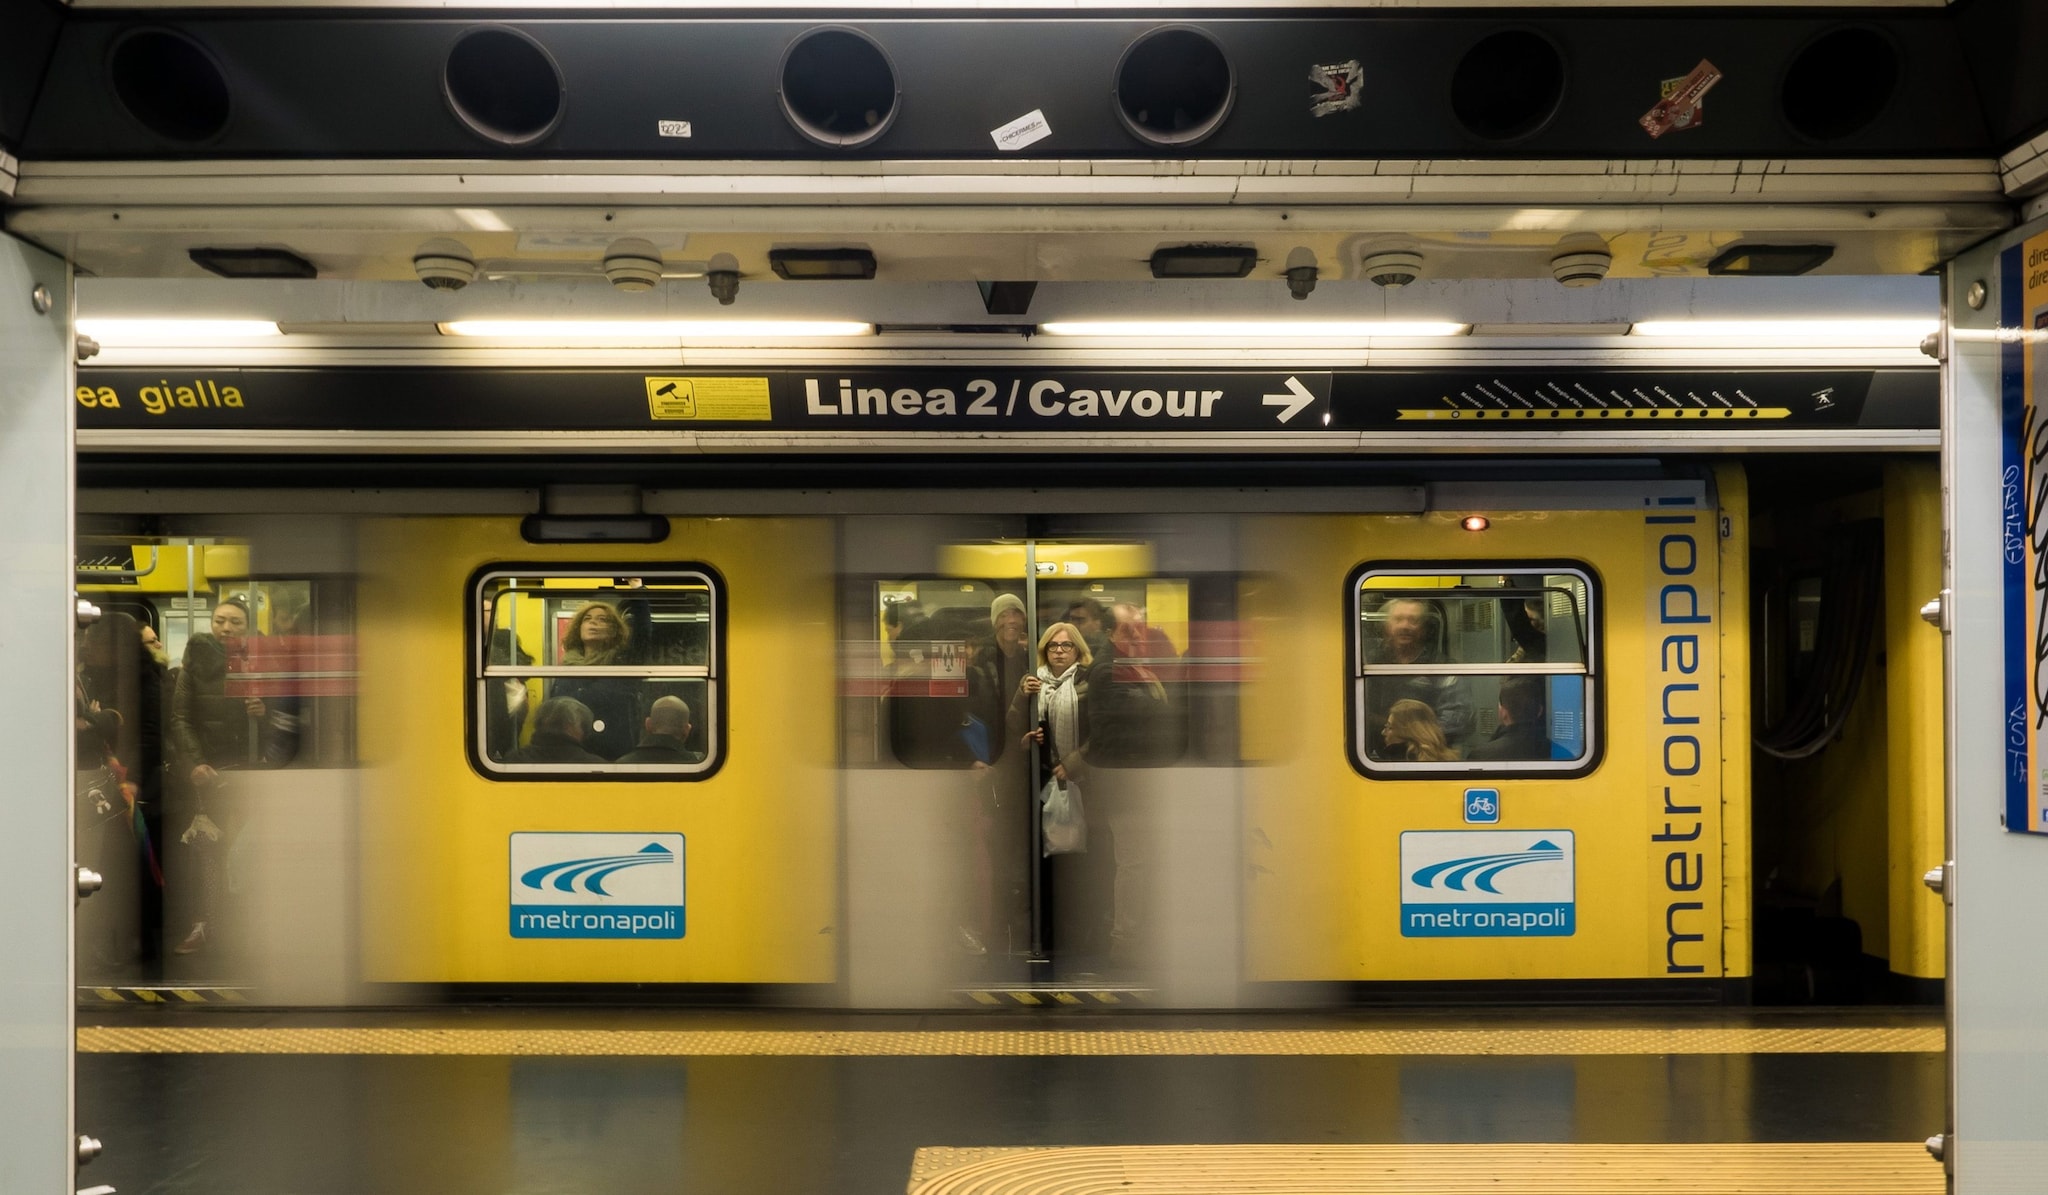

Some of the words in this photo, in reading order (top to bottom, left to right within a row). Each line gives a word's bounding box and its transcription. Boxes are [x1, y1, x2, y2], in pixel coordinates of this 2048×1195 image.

[139, 379, 244, 414] gialla
[805, 380, 957, 416] Linea
[1028, 380, 1224, 417] Cavour
[1722, 516, 1730, 538] 3
[1645, 497, 1711, 974] metronapoli
[520, 910, 676, 934] metronapoli
[1410, 908, 1566, 931] metronapoli
